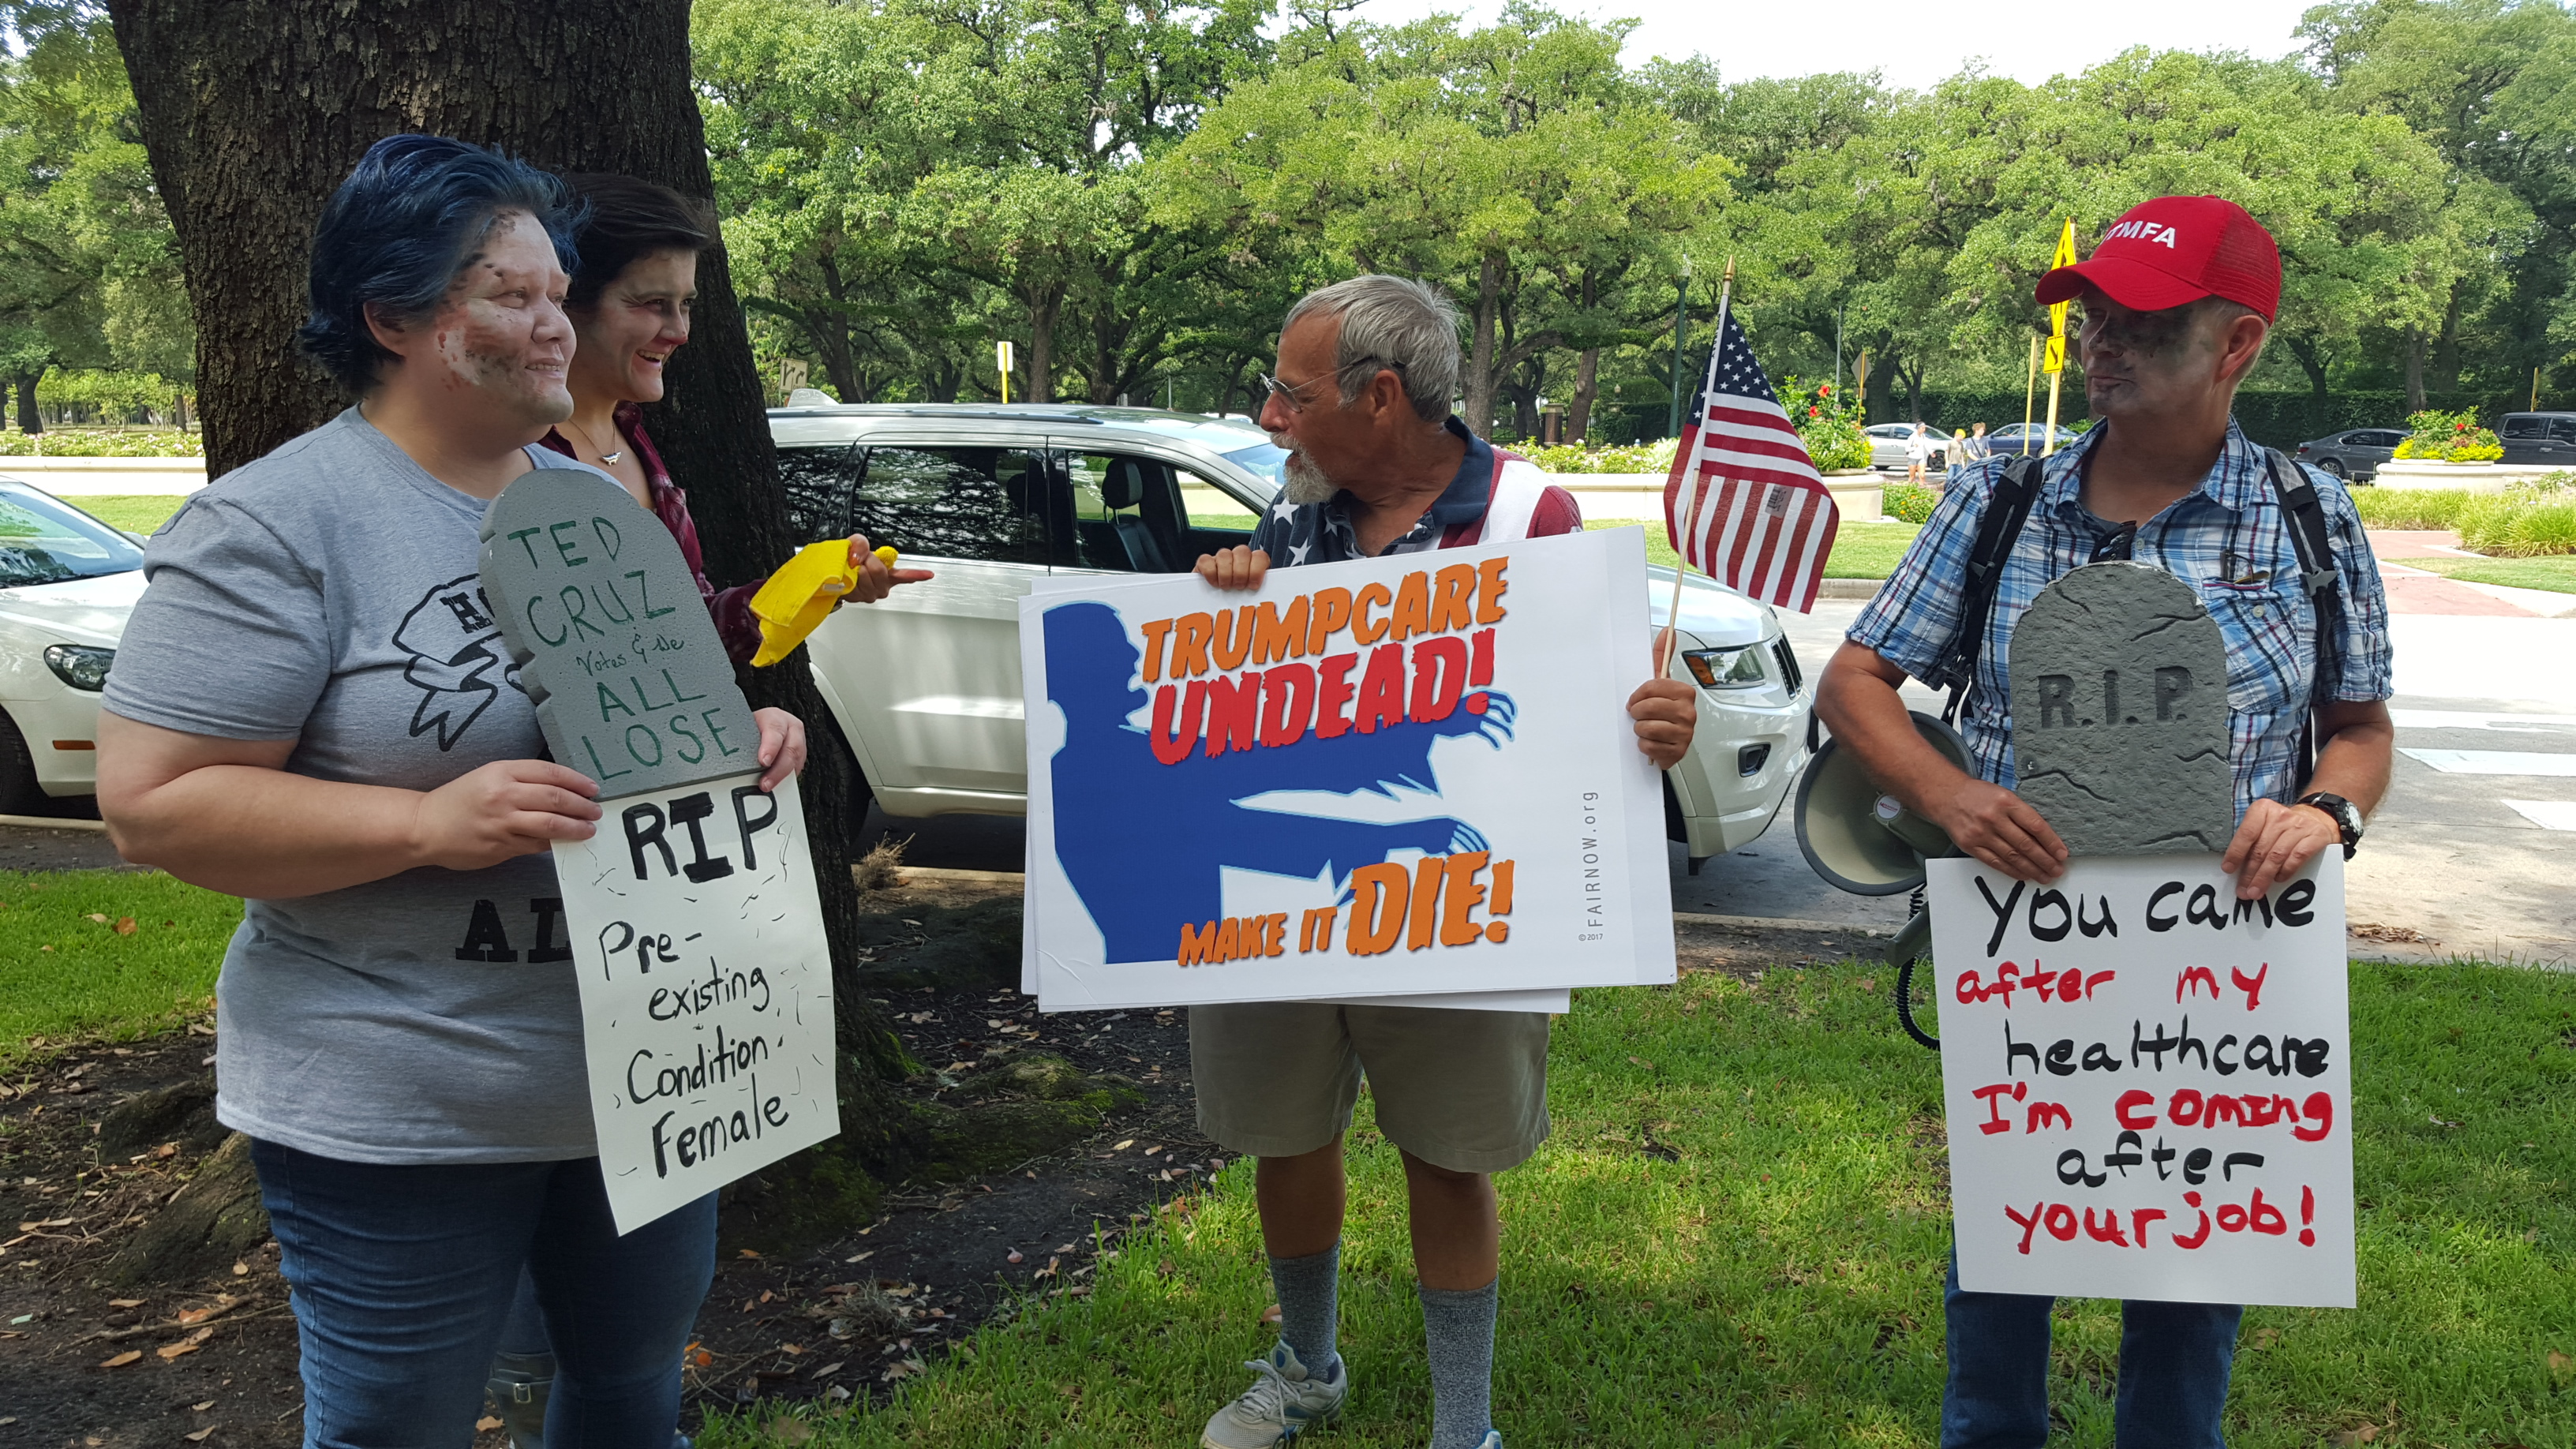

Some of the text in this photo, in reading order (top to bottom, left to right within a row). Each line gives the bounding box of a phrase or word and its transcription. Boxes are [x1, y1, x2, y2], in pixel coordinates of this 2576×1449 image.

[507, 517, 621, 570] TED
[526, 571, 676, 647] CRUZ
[1141, 556, 1510, 683] TRUMPCARE
[575, 650, 627, 677] Votes
[597, 669, 708, 722] ALL
[1149, 627, 1496, 765] UNDEAD!
[2037, 665, 2193, 729] R.I.P.
[581, 707, 740, 781] LOSE
[622, 784, 778, 884] RIP
[1582, 792, 1604, 927] FAIRNOW.org
[1178, 849, 1516, 966] MAKE IT DIE!
[2145, 878, 2317, 933] came
[648, 956, 771, 1021] existing
[1956, 959, 2269, 1012] after my
[627, 1025, 769, 1105] Condition
[2004, 1013, 2331, 1079] healthcare
[1971, 1081, 2073, 1136] I'm
[2056, 1130, 2265, 1188] after
